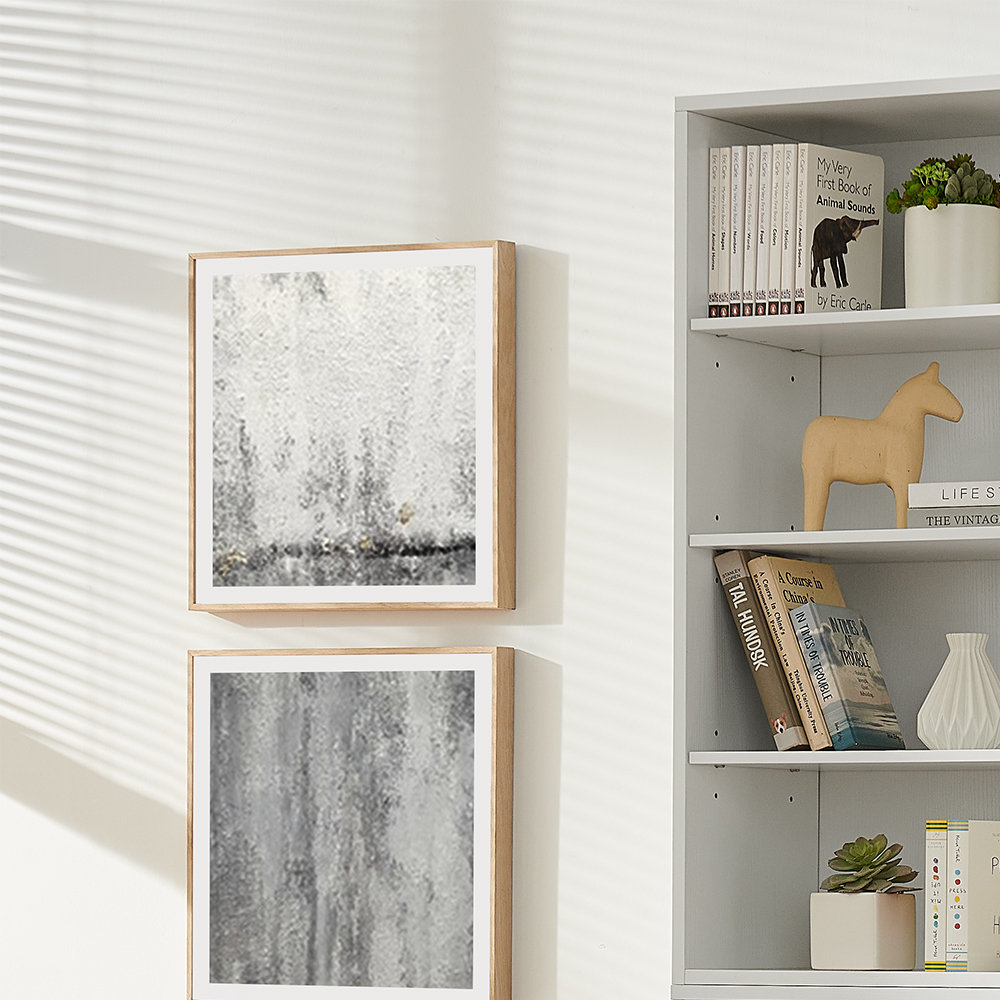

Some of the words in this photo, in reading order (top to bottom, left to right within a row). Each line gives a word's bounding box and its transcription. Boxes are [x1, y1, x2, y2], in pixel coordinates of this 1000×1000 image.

[817, 157, 831, 175] My
[831, 159, 852, 179] Very
[817, 174, 835, 191] First
[838, 178, 861, 195] Book
[862, 183, 873, 197] of
[816, 194, 845, 210] Animal
[847, 200, 876, 215] Sounds
[817, 292, 828, 309] by
[830, 294, 846, 309] Eric
[848, 297, 872, 311] Carle
[925, 516, 951, 527] THE
[777, 570, 786, 584] A
[785, 572, 813, 588] Course
[813, 576, 824, 590] in
[728, 581, 748, 609] TAL
[783, 589, 815, 605] China's
[753, 573, 772, 618] Environmental
[769, 619, 784, 652] Protection
[762, 578, 773, 601] Course
[773, 612, 786, 636] China's
[795, 611, 806, 624] IN
[828, 617, 840, 633] IN
[838, 618, 860, 636] TIMES
[737, 608, 769, 672] HUNDSK
[799, 625, 816, 650] TIMES
[844, 634, 854, 651] OF
[808, 650, 820, 662] OF
[839, 649, 872, 669] TROUBLE
[812, 662, 833, 702] TROUBLE
[795, 694, 803, 710] China
[810, 719, 818, 734] Press
